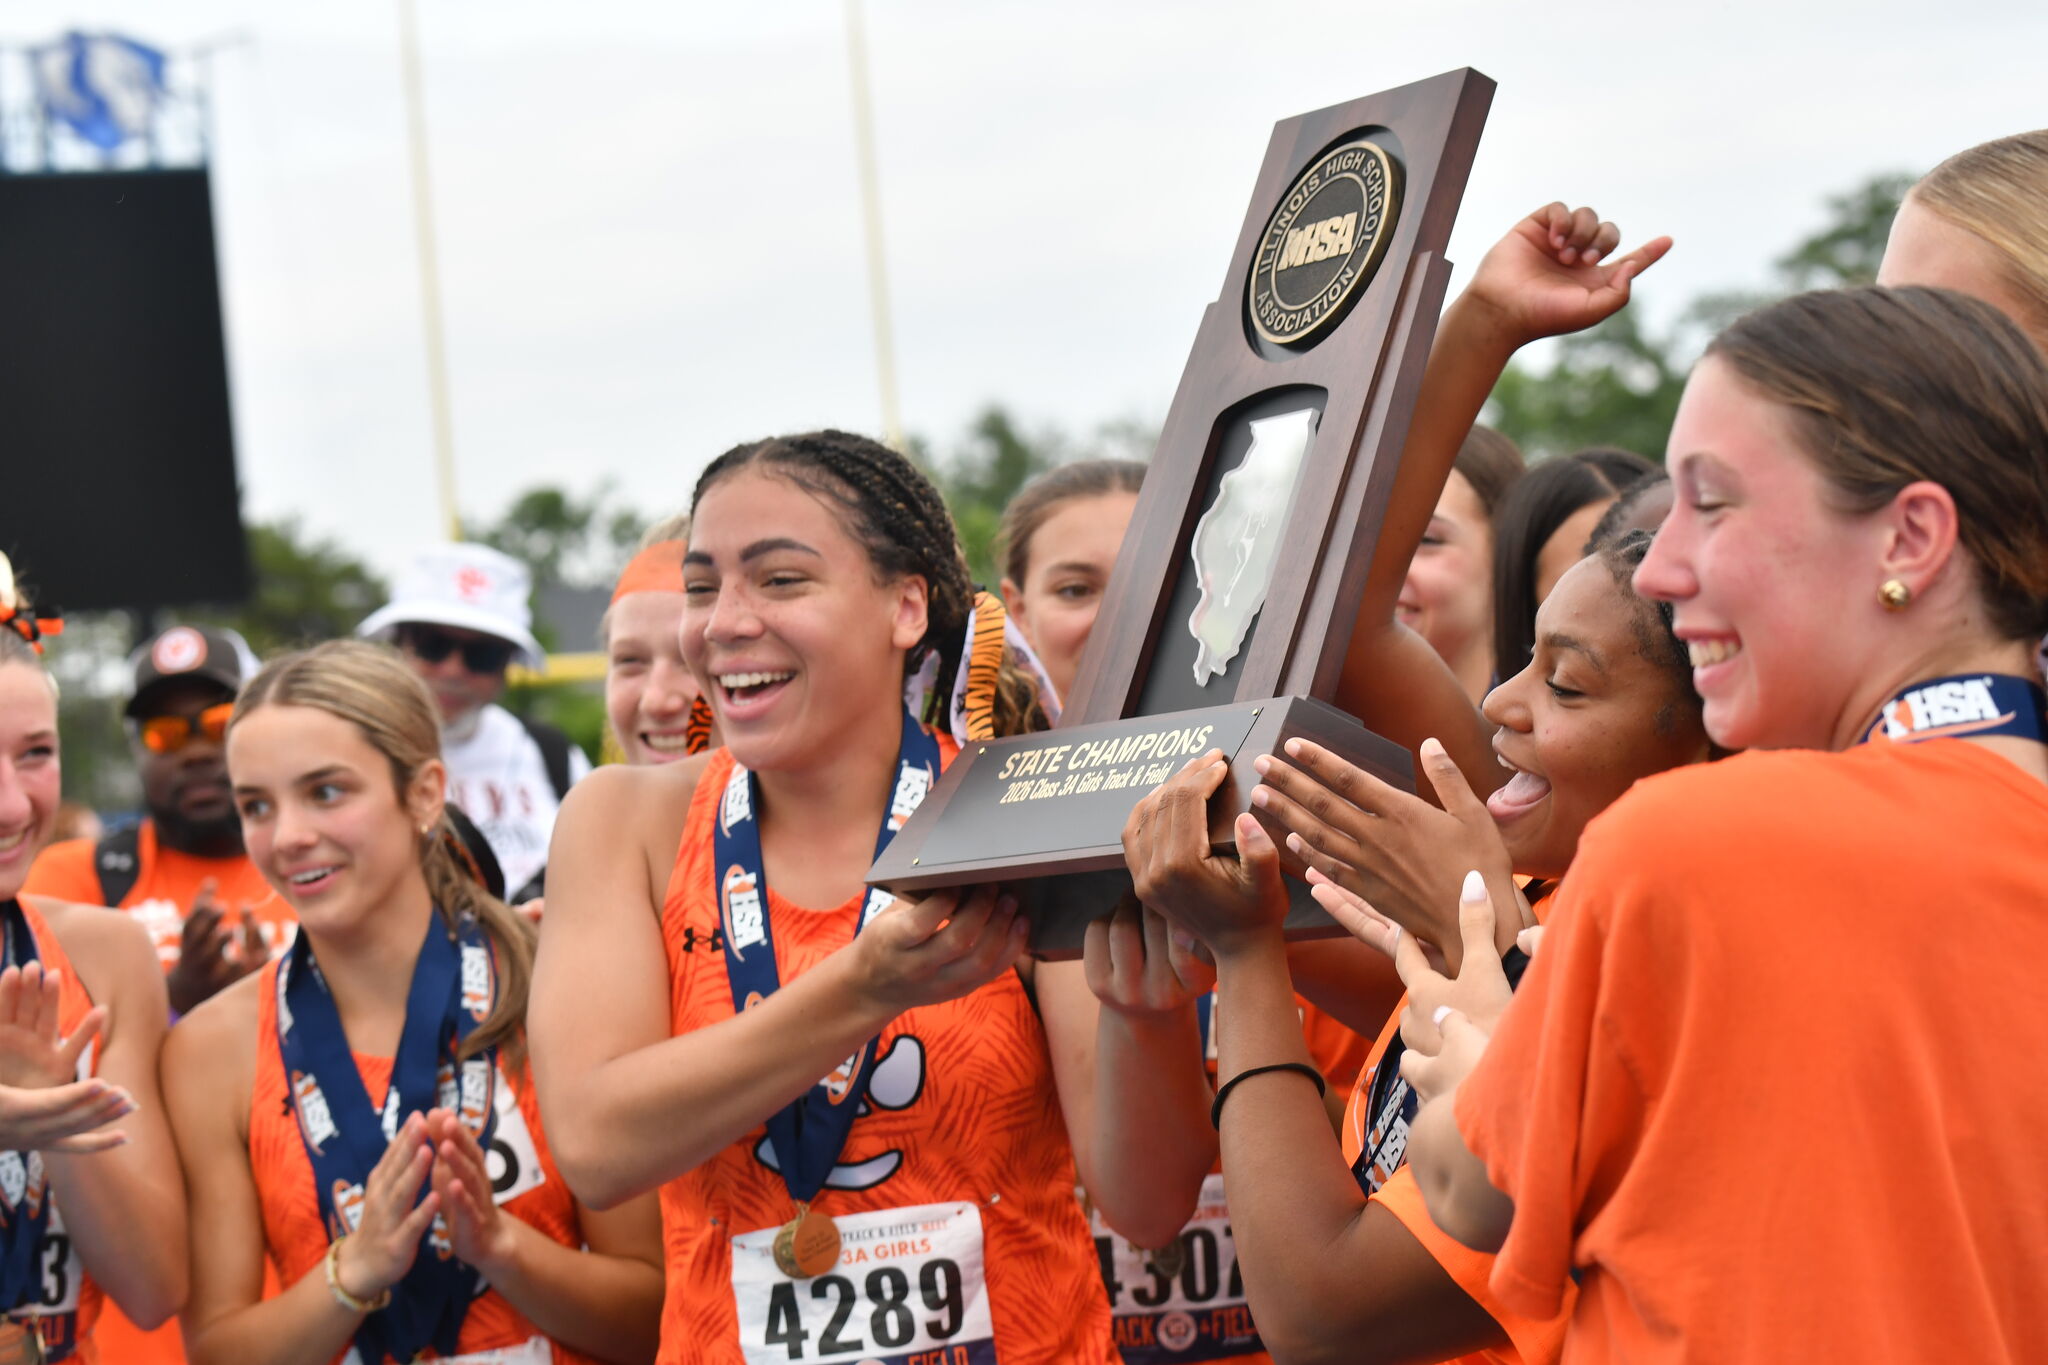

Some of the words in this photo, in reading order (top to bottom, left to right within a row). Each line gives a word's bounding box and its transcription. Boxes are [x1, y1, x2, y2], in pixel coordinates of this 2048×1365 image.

[1259, 174, 1320, 275] ILLINOIS
[1325, 151, 1365, 179] HIGH
[1357, 158, 1384, 249] SCHOOL
[1257, 266, 1355, 333] ASSOCIATION
[998, 745, 1072, 780] STATE
[1067, 725, 1214, 770] CHAMPIONS
[999, 779, 1035, 804] 2026
[1029, 777, 1060, 800] Class
[1058, 775, 1079, 796] 3A
[1075, 770, 1103, 794] Girls
[1101, 766, 1133, 791] Track
[1130, 765, 1145, 787] &
[1139, 761, 1175, 785] Field
[841, 1247, 869, 1265] 3A
[874, 1238, 932, 1260] GIRLS
[842, 1229, 874, 1243] TRACK
[889, 1223, 918, 1236] FIELD
[765, 1258, 964, 1360] 4289
[1211, 1305, 1257, 1339] FIEL
